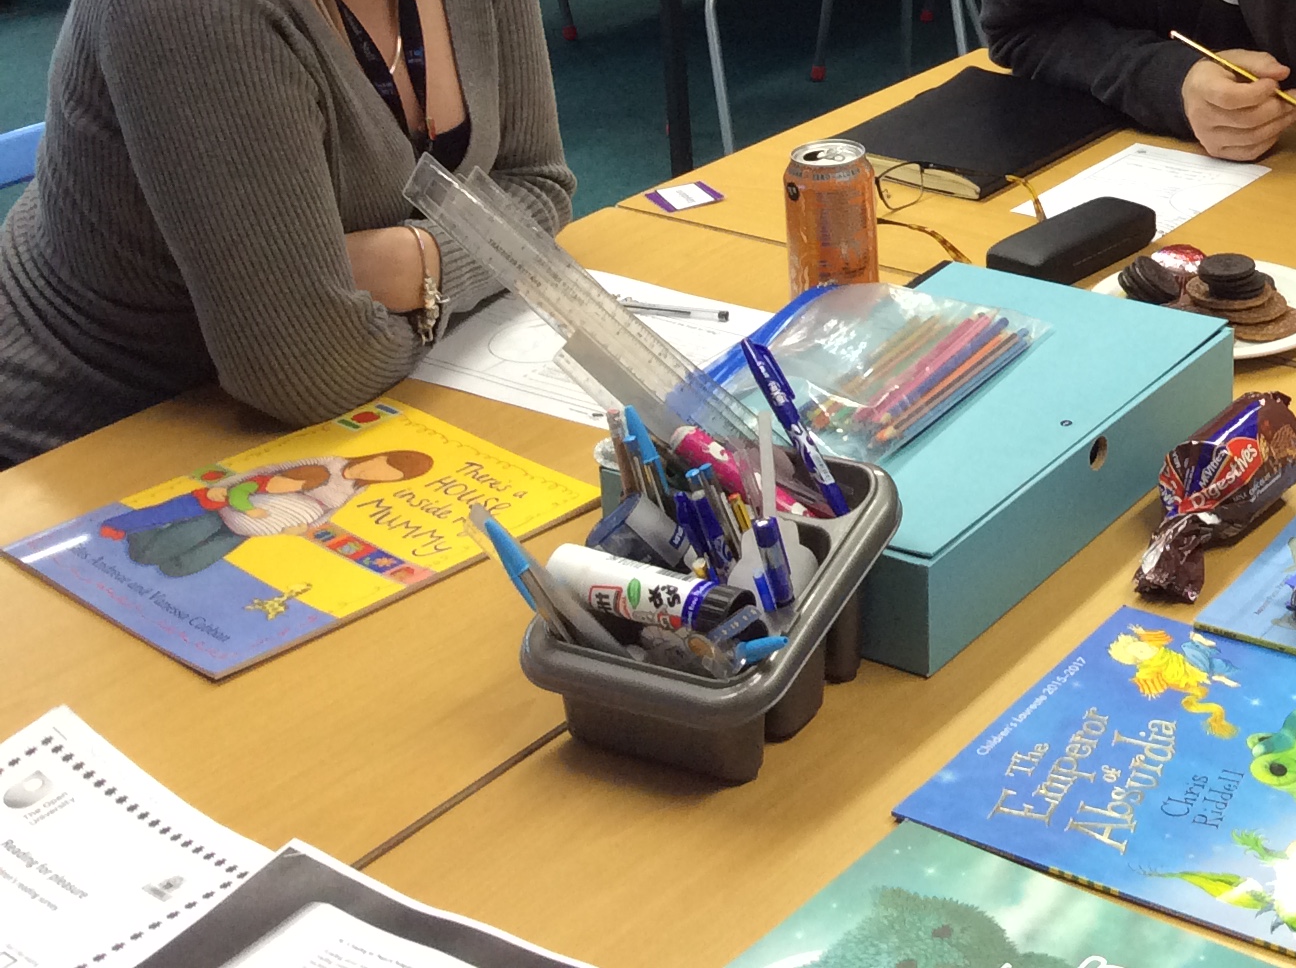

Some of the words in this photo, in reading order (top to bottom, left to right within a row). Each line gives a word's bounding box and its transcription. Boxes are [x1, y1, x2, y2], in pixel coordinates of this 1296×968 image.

[456, 461, 512, 493] There's
[513, 490, 528, 499] a
[1189, 443, 1258, 509] Digestives
[393, 488, 453, 520] inside
[127, 579, 150, 596] and
[149, 589, 190, 622] Vanessa
[976, 716, 1018, 757] Children's
[1013, 693, 1049, 724] Laureate
[1042, 656, 1087, 697] 2015-2017
[986, 706, 1109, 828] Emperor
[1005, 742, 1050, 777] The
[1102, 764, 1122, 783] of
[23, 808, 42, 821] The
[42, 791, 69, 809] Open
[1064, 719, 1178, 856] Absurdia
[1160, 773, 1209, 818] Chris
[1192, 768, 1245, 830] Riddell
[29, 797, 76, 826] University
[1, 839, 39, 868] Reading
